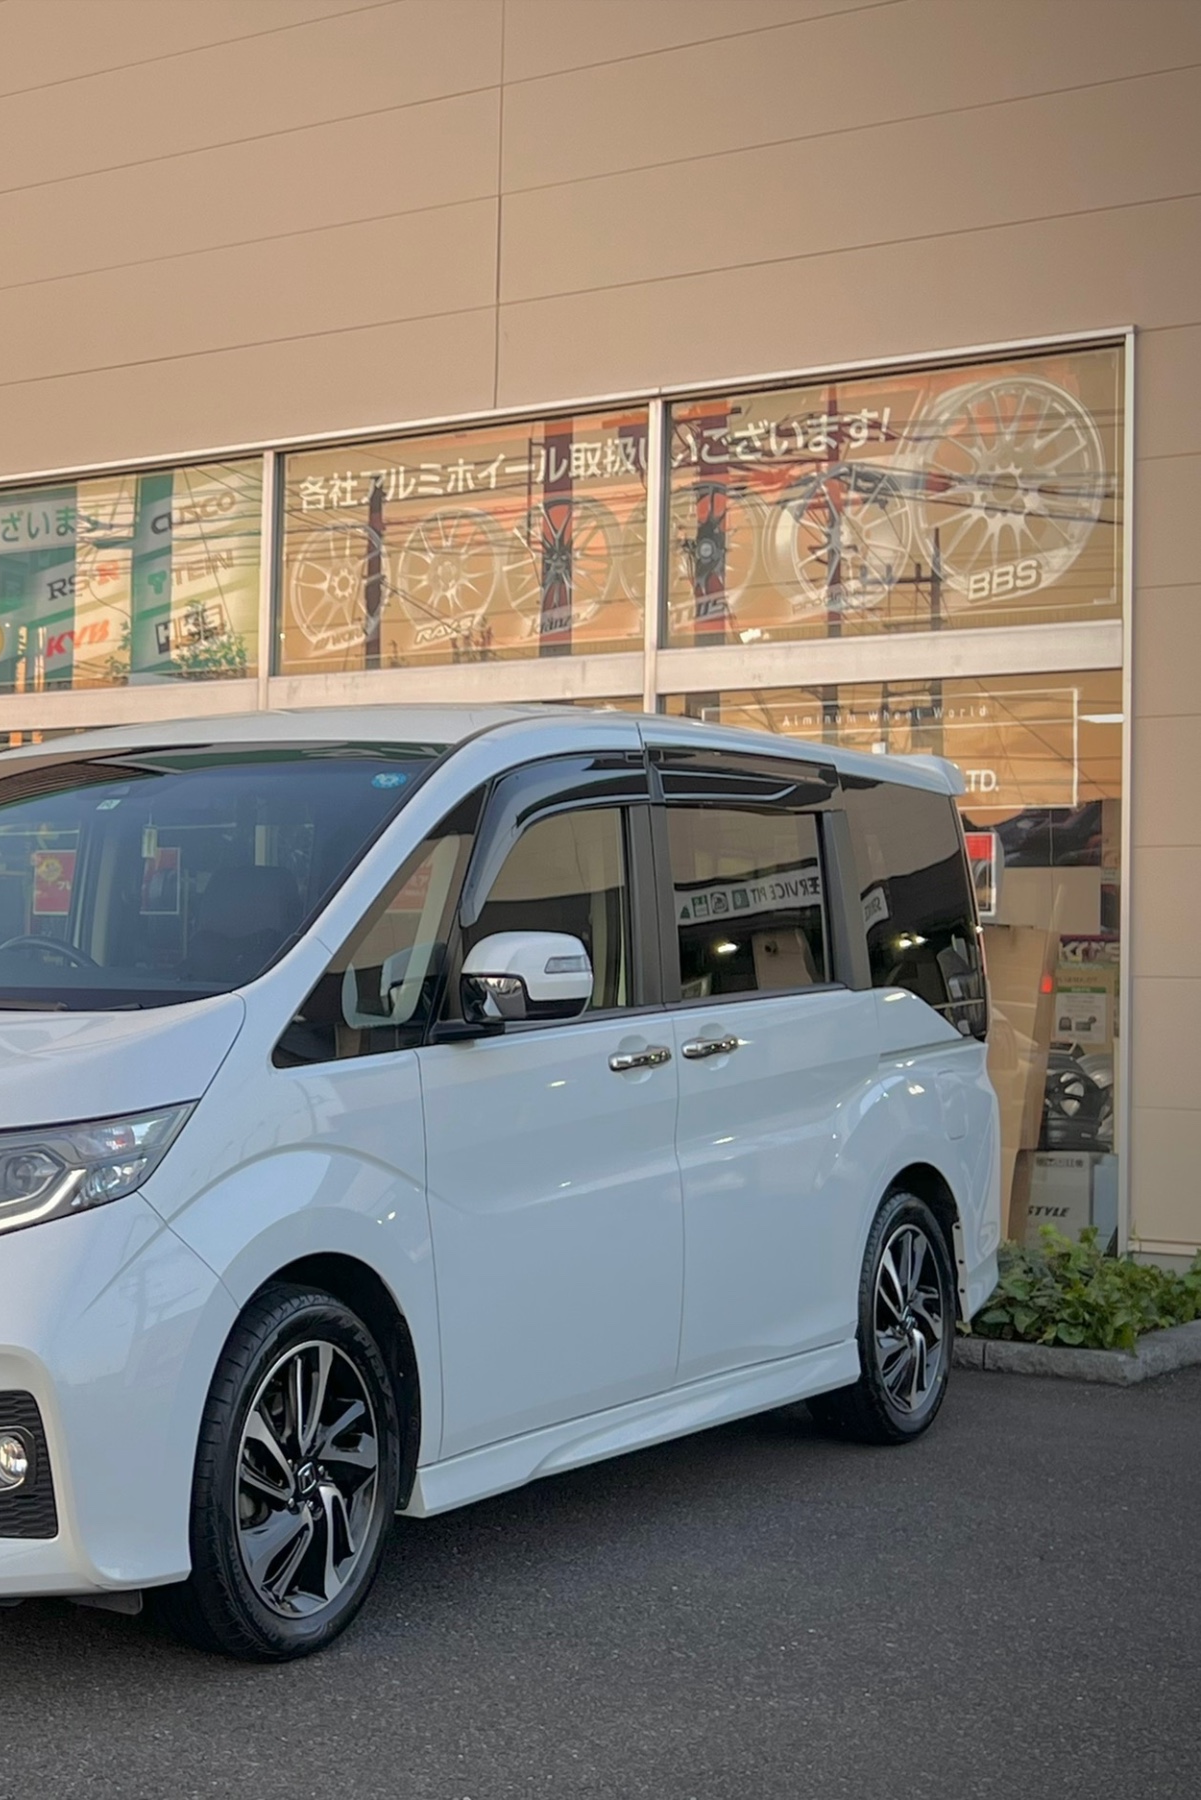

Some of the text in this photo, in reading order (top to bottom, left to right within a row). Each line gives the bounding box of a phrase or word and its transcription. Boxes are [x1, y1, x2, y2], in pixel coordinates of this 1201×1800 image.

[175, 548, 235, 586] TEIN
[967, 559, 1040, 602] BBS
[45, 618, 110, 658] KYB
[964, 768, 999, 793] TD.
